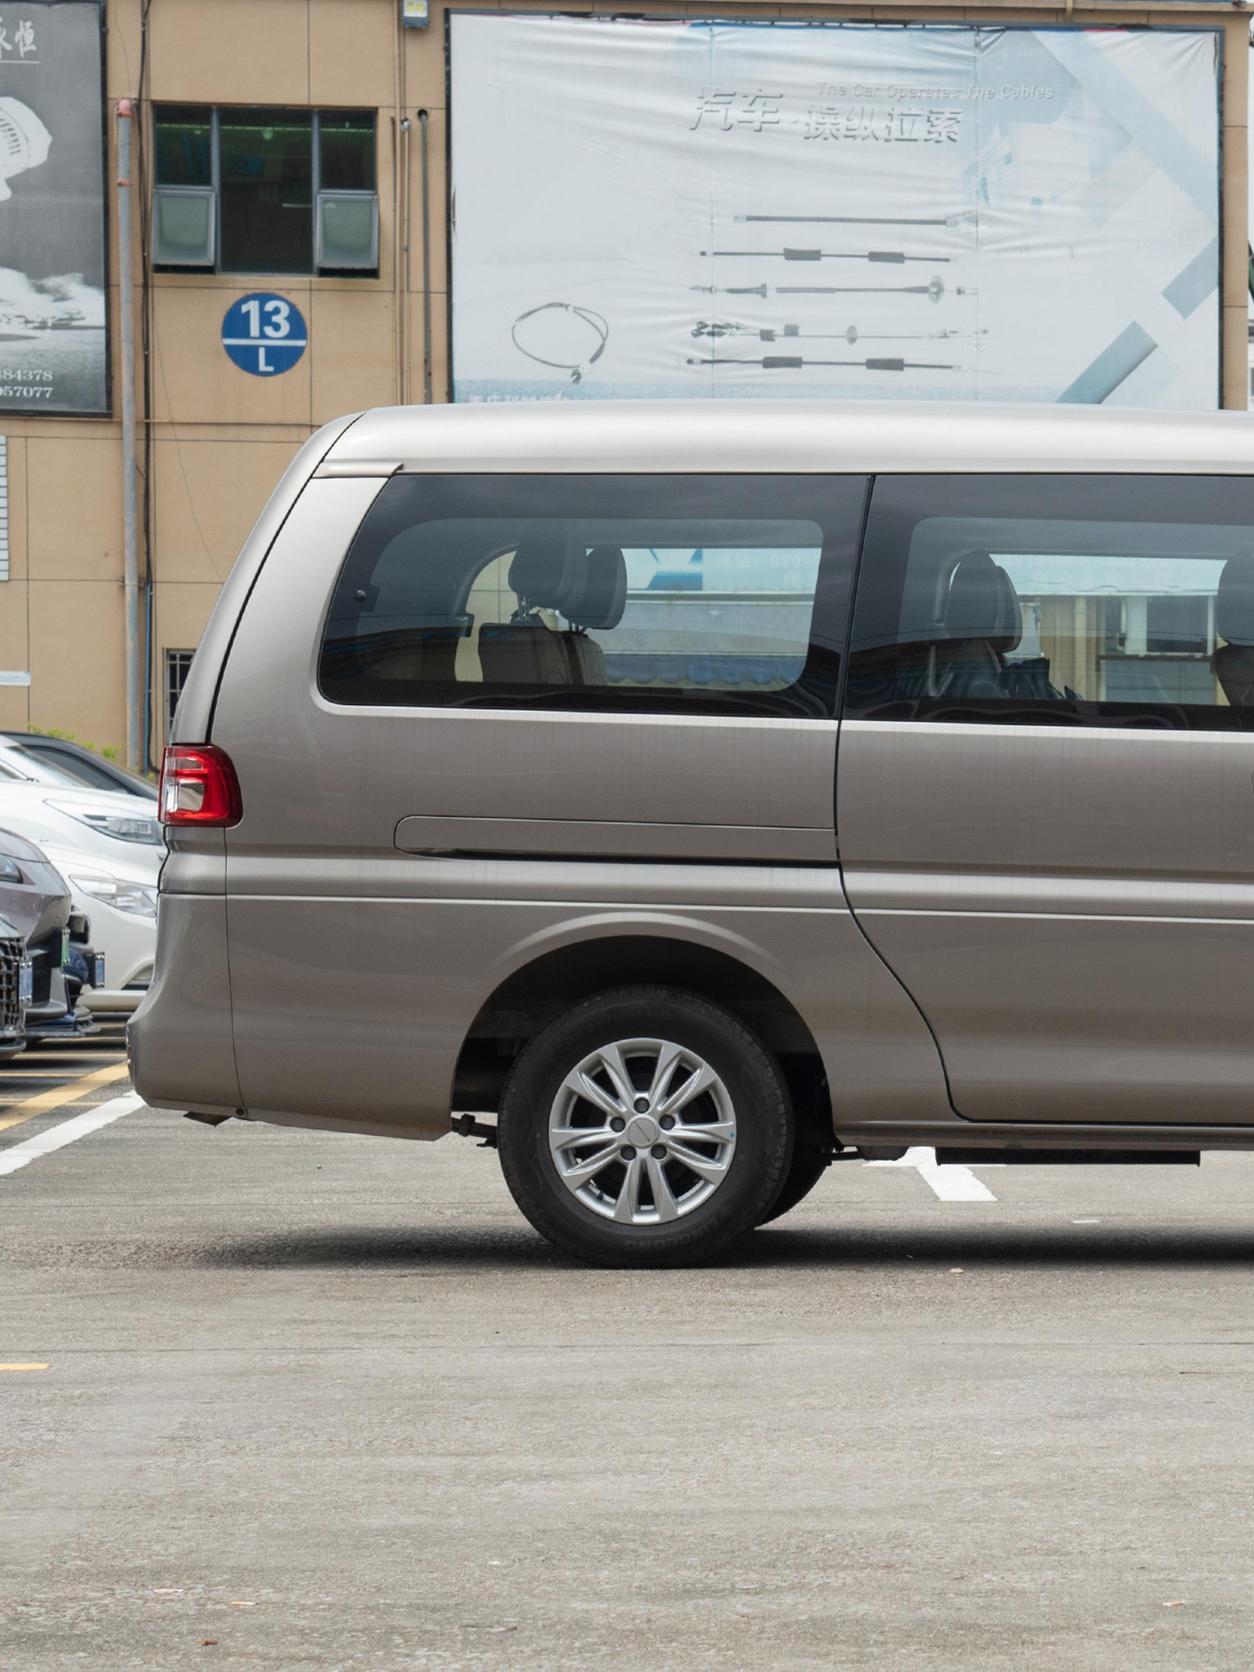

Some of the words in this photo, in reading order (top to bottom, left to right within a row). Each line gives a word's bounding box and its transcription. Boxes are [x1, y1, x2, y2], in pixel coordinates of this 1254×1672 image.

[816, 82, 847, 96] The
[854, 83, 880, 98] Car
[887, 84, 960, 102] Operates
[967, 84, 994, 99] The
[1000, 84, 1055, 100] Cables
[240, 300, 290, 339] 13
[258, 346, 274, 372] L
